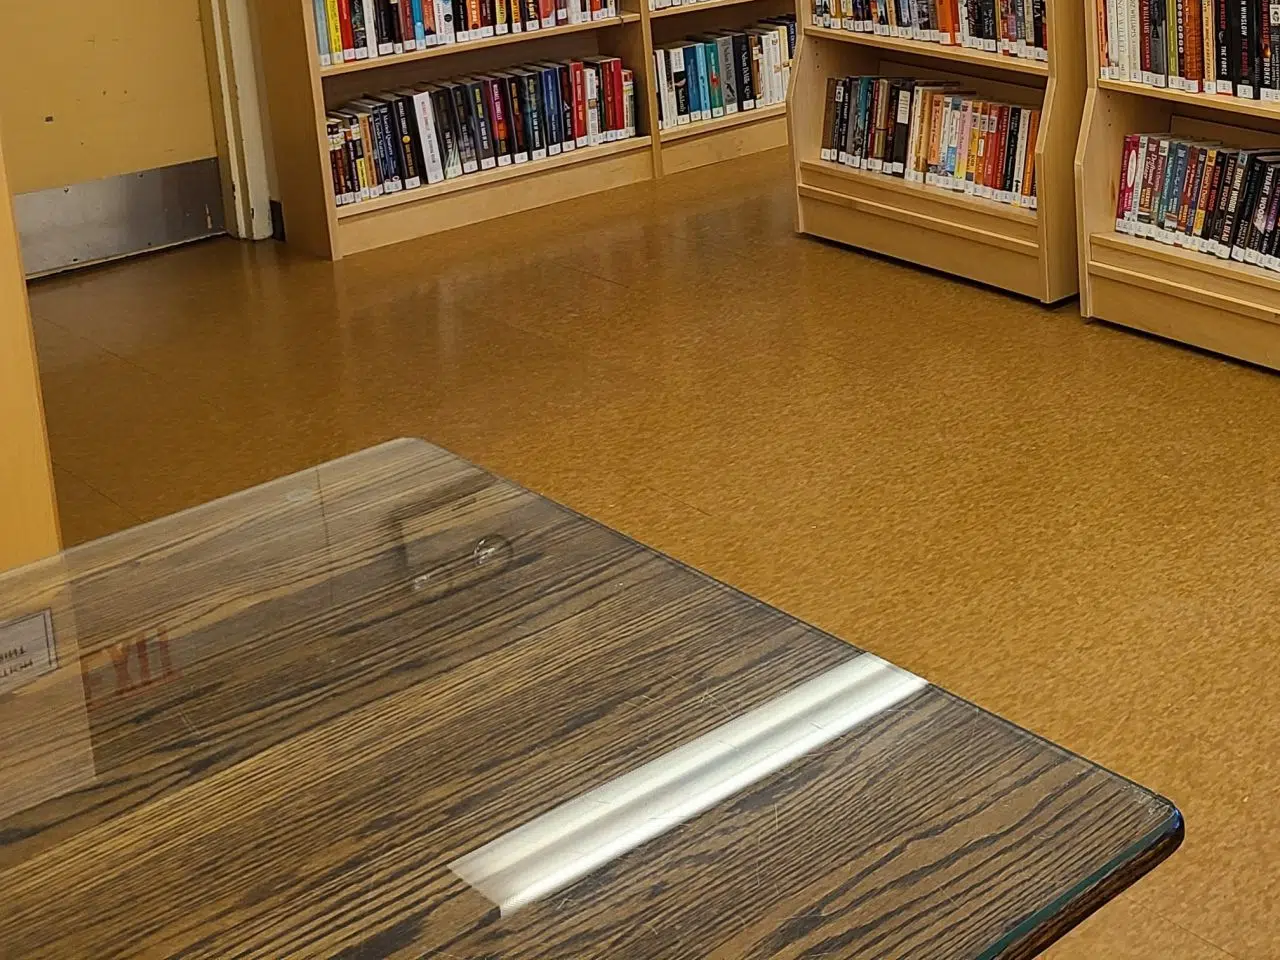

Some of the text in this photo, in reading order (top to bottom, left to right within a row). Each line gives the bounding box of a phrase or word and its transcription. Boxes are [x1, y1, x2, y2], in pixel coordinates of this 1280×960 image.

[1142, 6, 1150, 34] WILLIAMS
[1240, 5, 1248, 36] WINSLOW
[1262, 13, 1270, 44] WINSLOW
[1220, 57, 1228, 75] FORCE
[1263, 57, 1271, 85] BROKEN
[383, 114, 391, 134] Married
[1147, 154, 1157, 185] Driftwood
[1219, 159, 1234, 210] STUART WOODS
[1144, 187, 1152, 208] SHERRYL
[1208, 166, 1221, 211] STUART WOODS
[1255, 167, 1274, 224] STUART WOODS
[1222, 168, 1243, 242] STUART WOODS DEAD
